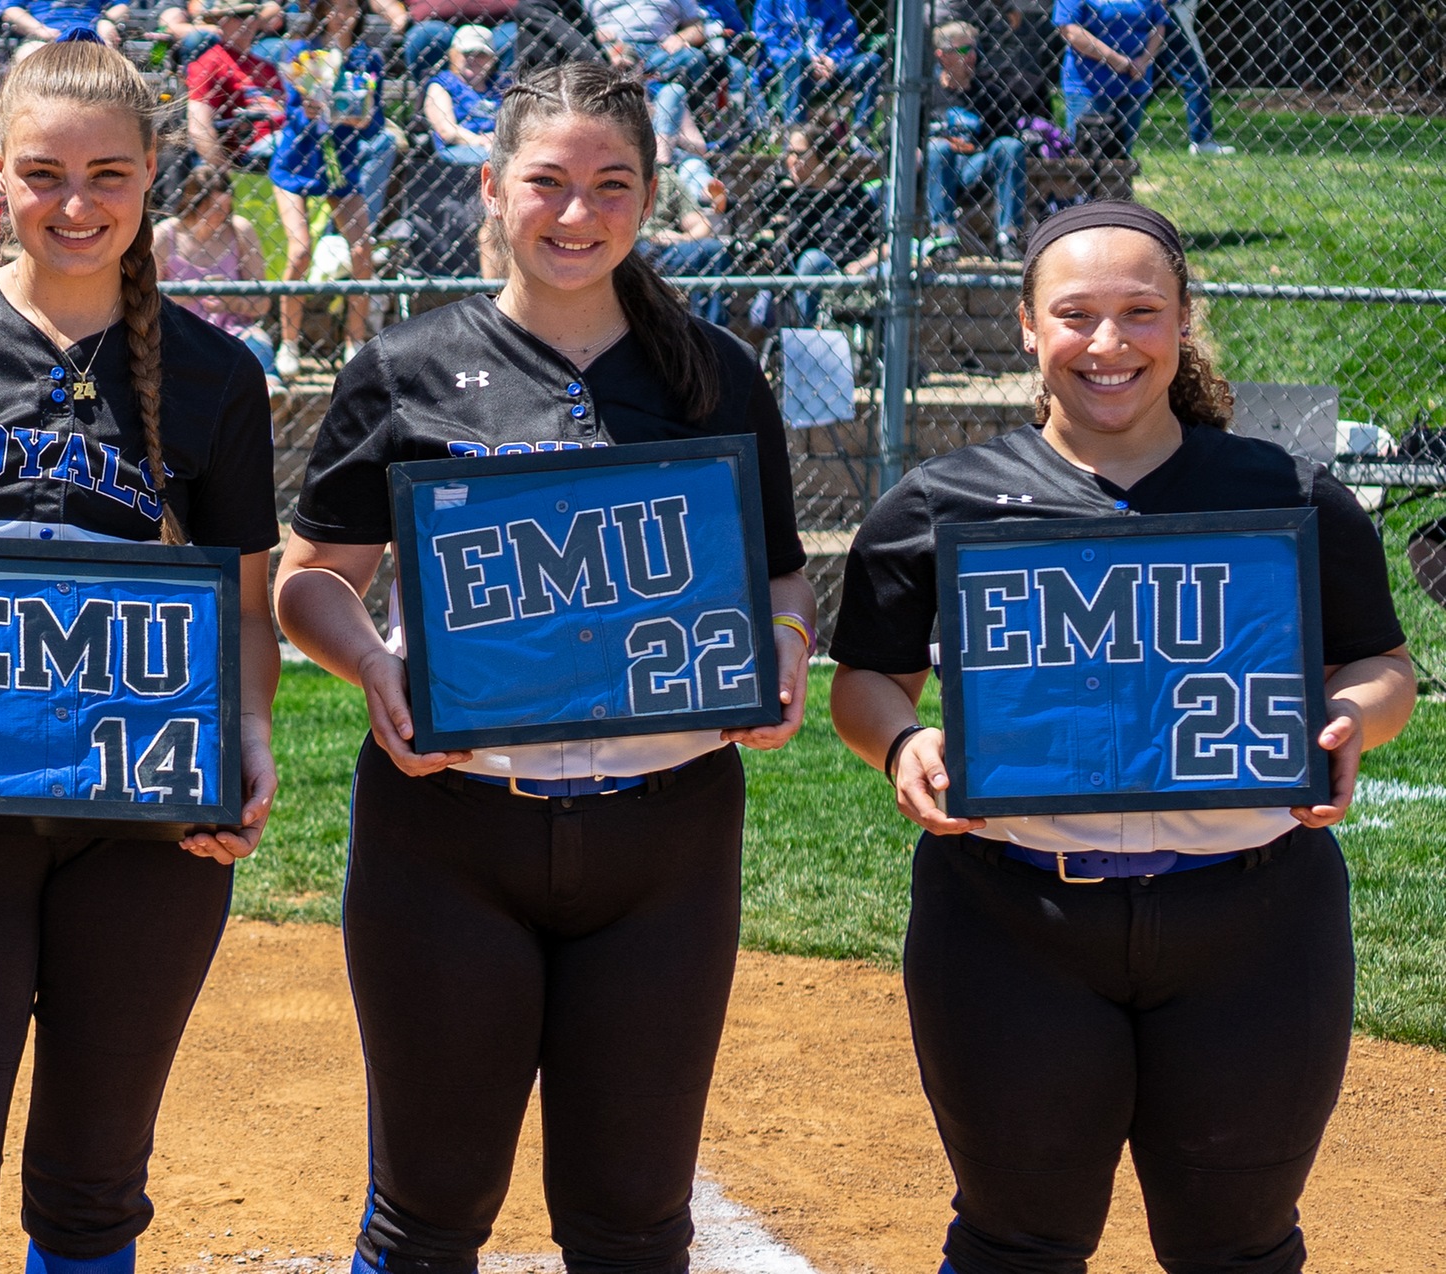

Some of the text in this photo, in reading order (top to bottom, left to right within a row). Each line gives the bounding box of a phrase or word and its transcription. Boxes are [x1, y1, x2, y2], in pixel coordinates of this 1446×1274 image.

[73, 382, 97, 400] 24
[432, 495, 693, 631] EMU
[625, 608, 756, 715] 22
[958, 563, 1230, 671] EMU
[89, 717, 203, 805] 14
[1171, 672, 1307, 781] 25
